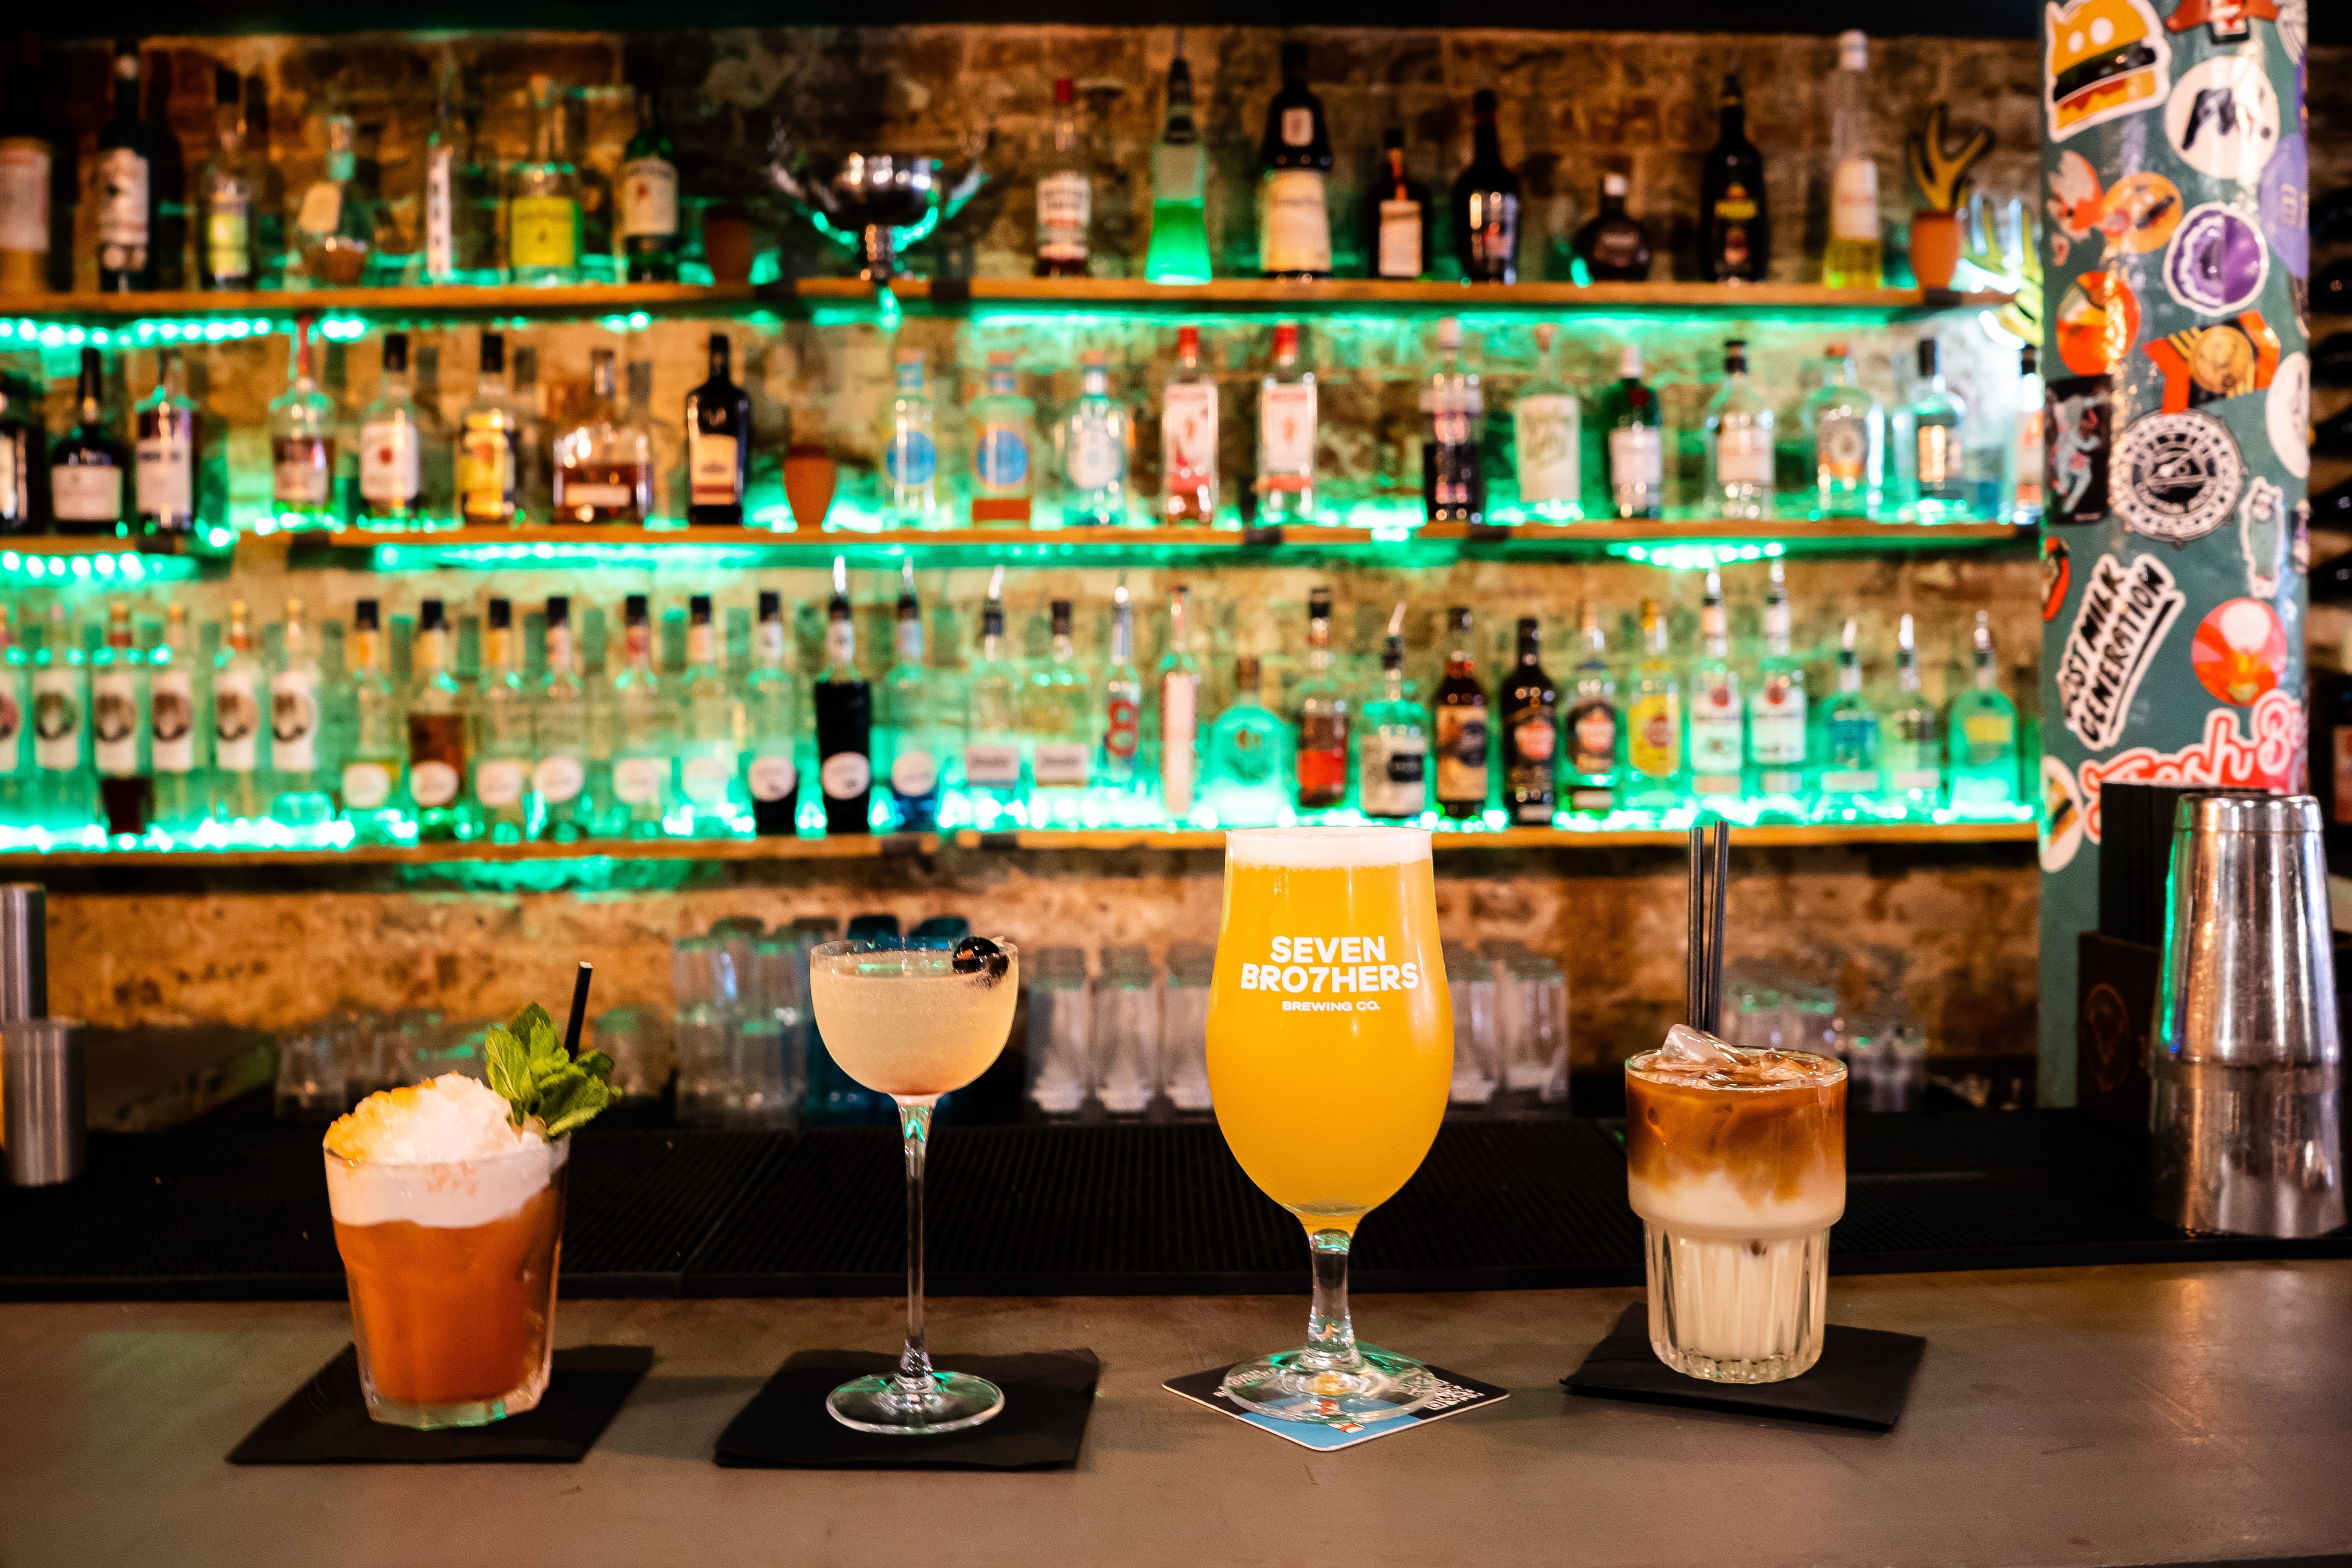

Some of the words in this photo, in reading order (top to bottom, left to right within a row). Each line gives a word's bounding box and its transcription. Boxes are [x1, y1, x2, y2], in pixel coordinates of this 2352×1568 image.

[2080, 563, 2124, 652] MILK
[2079, 563, 2165, 742] GENERATION
[1269, 935, 1386, 964] SEVEN
[1240, 962, 1420, 993] BRO7HERS
[1282, 1000, 1353, 1012] BREWING
[1356, 1000, 1381, 1011] CO.
